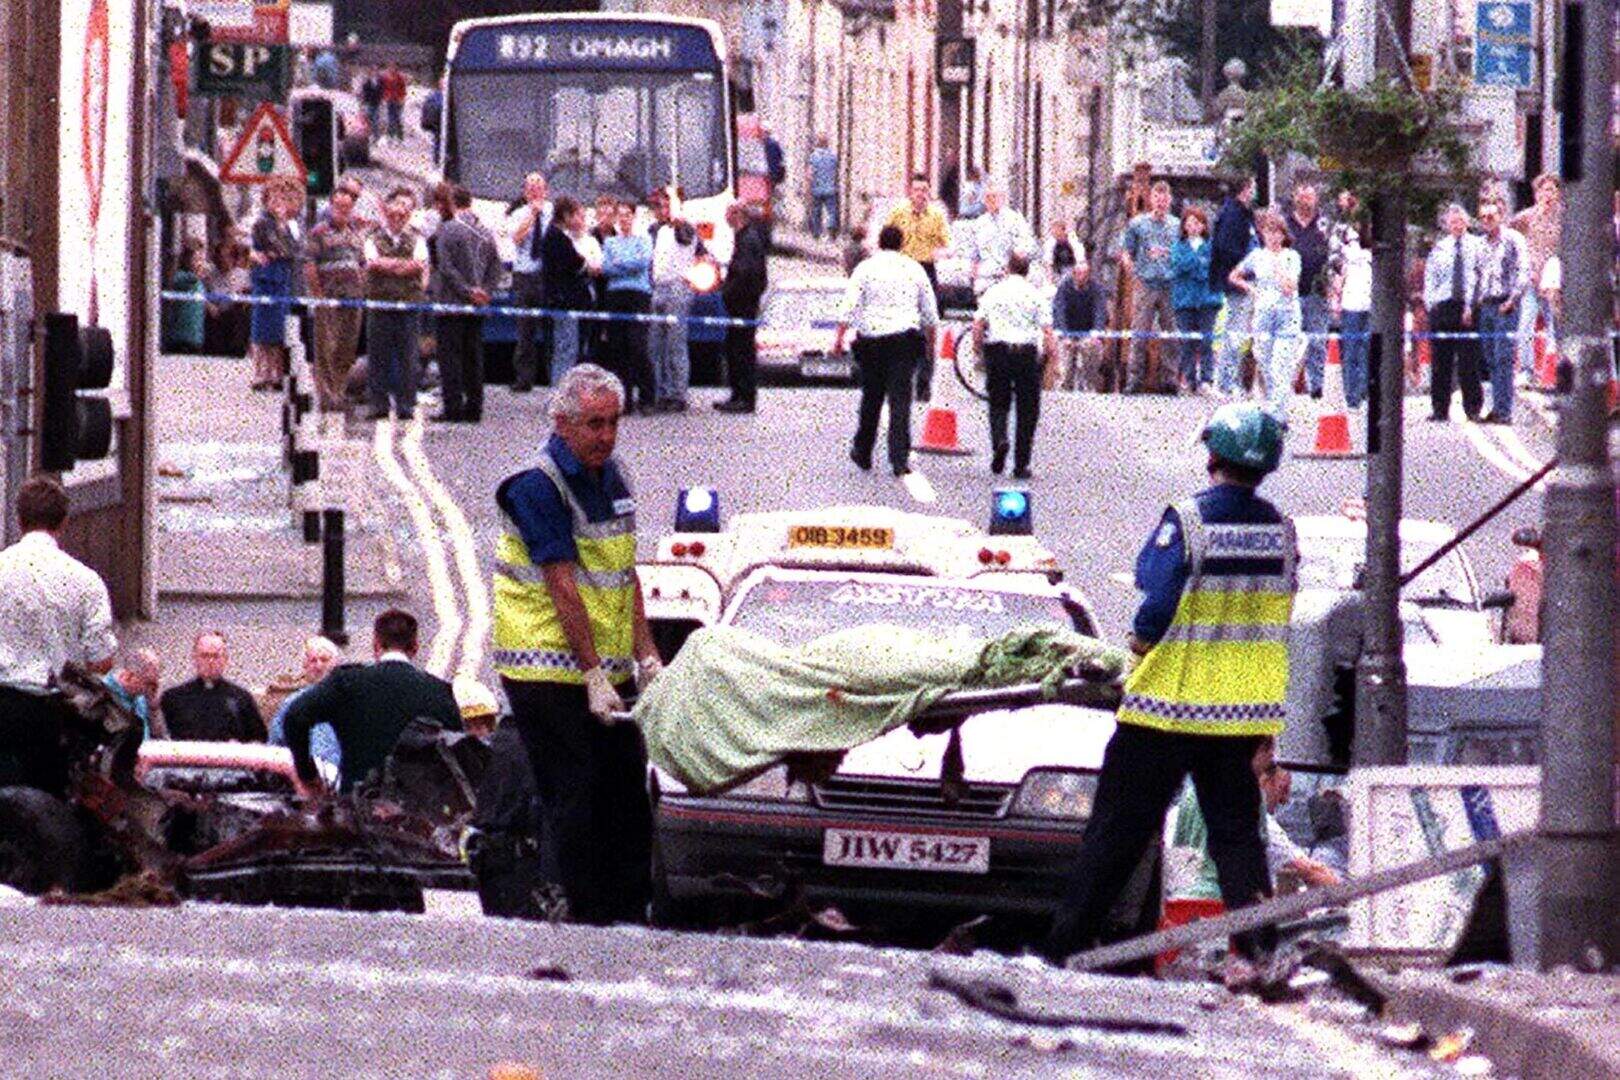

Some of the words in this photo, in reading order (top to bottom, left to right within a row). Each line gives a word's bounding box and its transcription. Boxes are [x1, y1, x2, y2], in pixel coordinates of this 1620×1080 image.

[570, 35, 671, 58] OMAGH
[1206, 530, 1283, 551] PARAMEDIC
[836, 833, 901, 861] JIW
[909, 840, 978, 864] 5427
